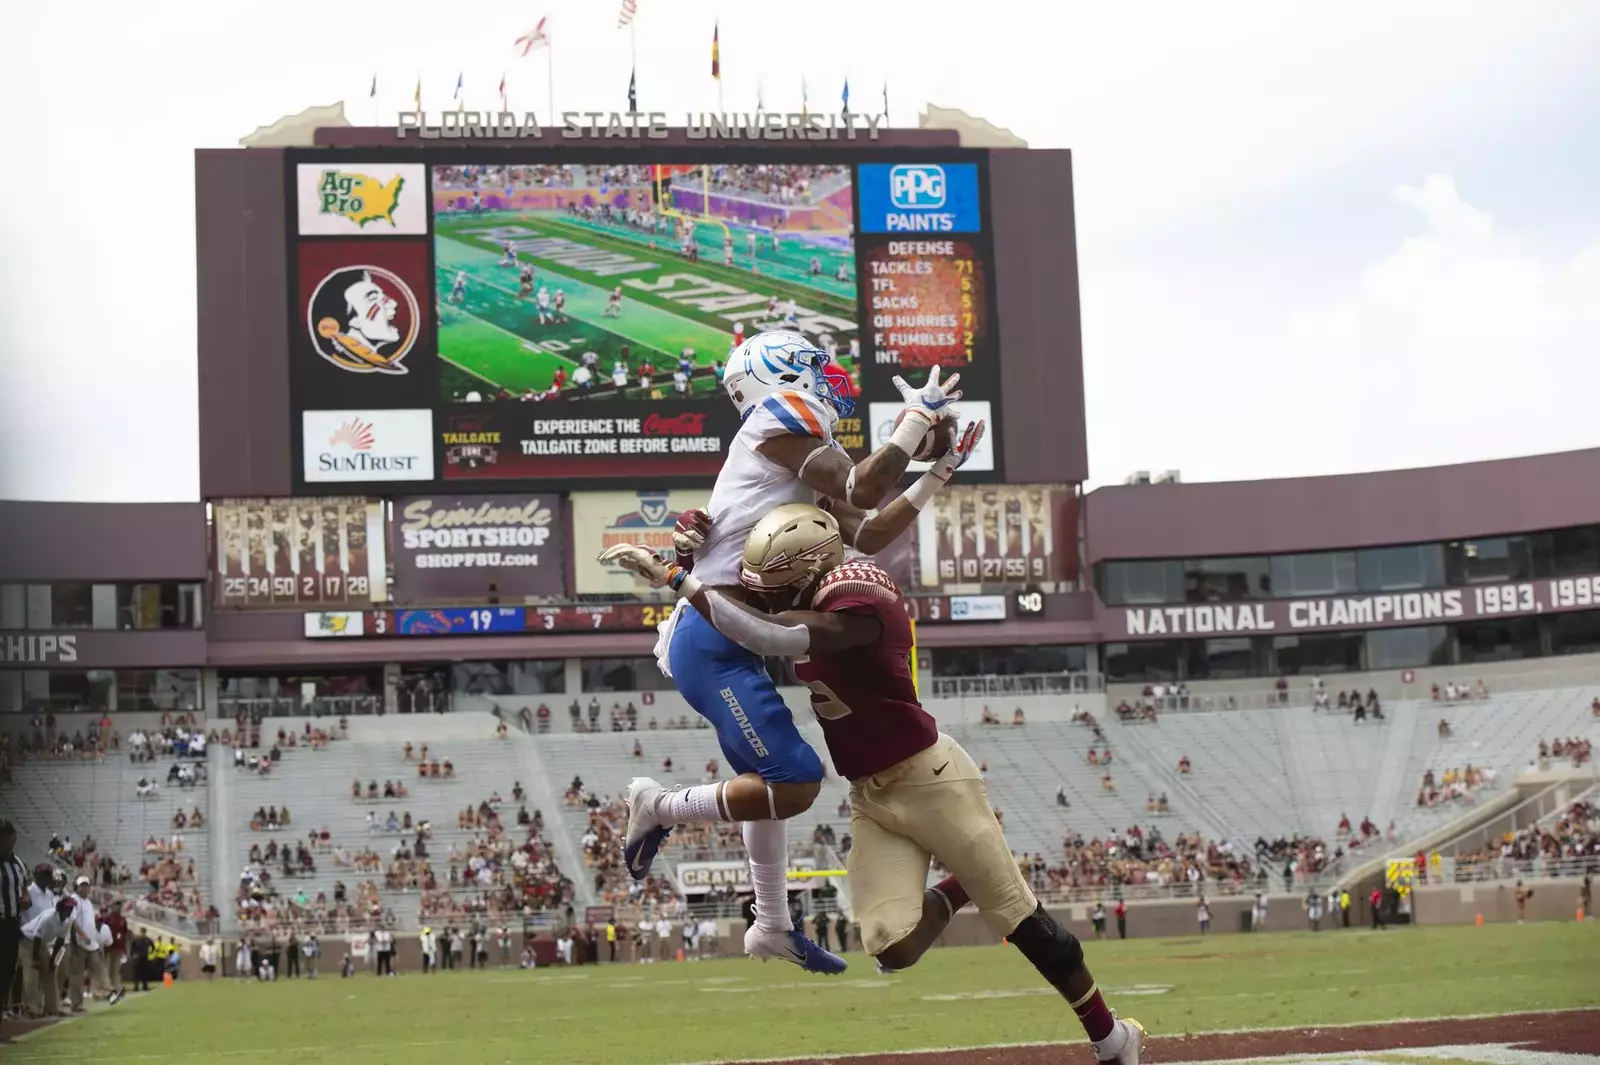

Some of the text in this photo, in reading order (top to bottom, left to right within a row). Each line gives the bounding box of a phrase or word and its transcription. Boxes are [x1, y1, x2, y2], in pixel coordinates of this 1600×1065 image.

[397, 111, 882, 140] FLORIDA STATE UNIVERSITY
[894, 169, 942, 204] PPG
[321, 193, 363, 213] Pro
[886, 213, 954, 232] PAINTS
[888, 241, 954, 255] DEFENSE
[871, 260, 973, 275] TACKLES 71
[871, 278, 896, 291] TFL
[872, 295, 918, 309] SACKS
[873, 313, 973, 328] QB HURRIES 7
[889, 332, 956, 346] FUMBLES
[964, 332, 974, 345] 2
[875, 349, 973, 364] INT. 1
[533, 419, 614, 435] EXPERIENCE
[615, 418, 641, 434] THE
[442, 432, 501, 444] TAILGATE
[520, 437, 721, 455] TAILGATE ZONE BEFORE GAMES!
[400, 498, 552, 533] Seminole
[403, 528, 550, 549] SPORTSHOP
[415, 553, 539, 568] SHOPFSU.COM
[962, 559, 978, 576] 10
[983, 559, 1001, 576] 27
[1006, 559, 1026, 576] 55
[1033, 559, 1044, 576] 9
[224, 576, 368, 596] 25 34 50 2 17 28
[1018, 592, 1042, 612] 40
[1125, 604, 1276, 635] NATIONAL
[1288, 589, 1464, 628] CHAMPIONS
[1474, 584, 1543, 613] 1993,
[469, 610, 493, 630] 19
[930, 605, 940, 620] 3
[375, 619, 386, 634] 3
[544, 614, 603, 630] 3 7
[720, 686, 769, 758] BRONCOS
[684, 868, 750, 886] CRANK
